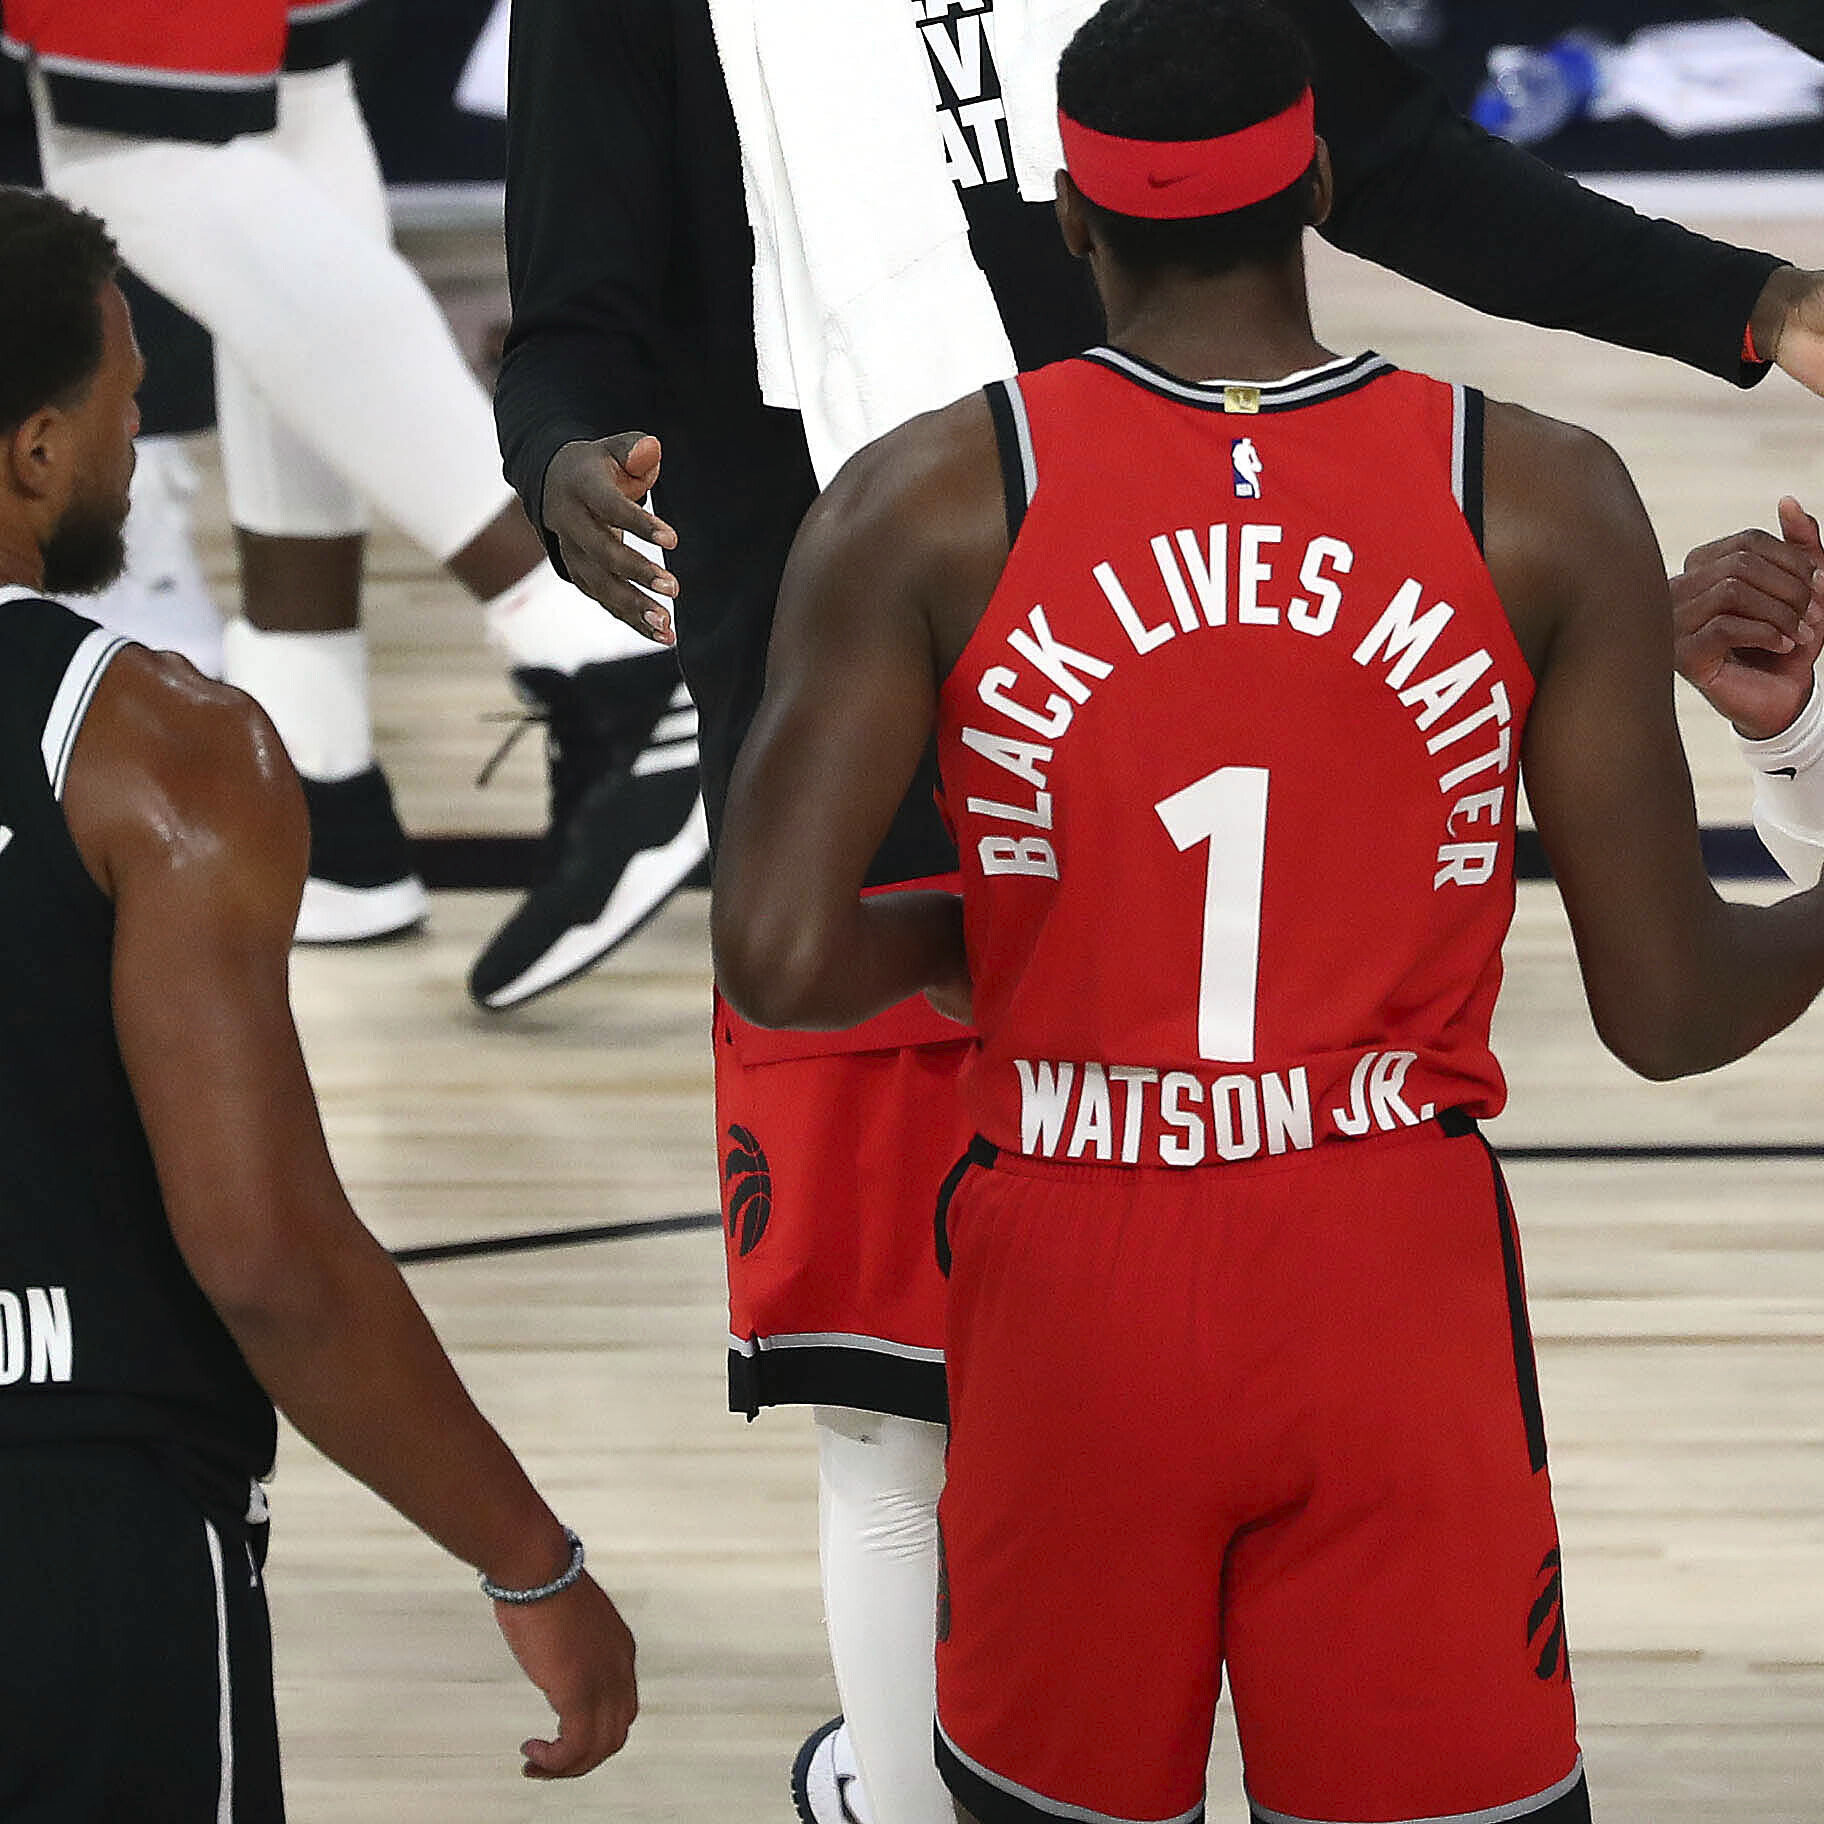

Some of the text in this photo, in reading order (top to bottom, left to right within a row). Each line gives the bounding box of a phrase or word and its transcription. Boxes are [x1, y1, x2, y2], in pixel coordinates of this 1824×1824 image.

[961, 523, 1512, 892] BLACK LIVES MATTER
[1153, 766, 1270, 1063] 1
[1013, 1050, 1435, 1167] WATSON JR.
